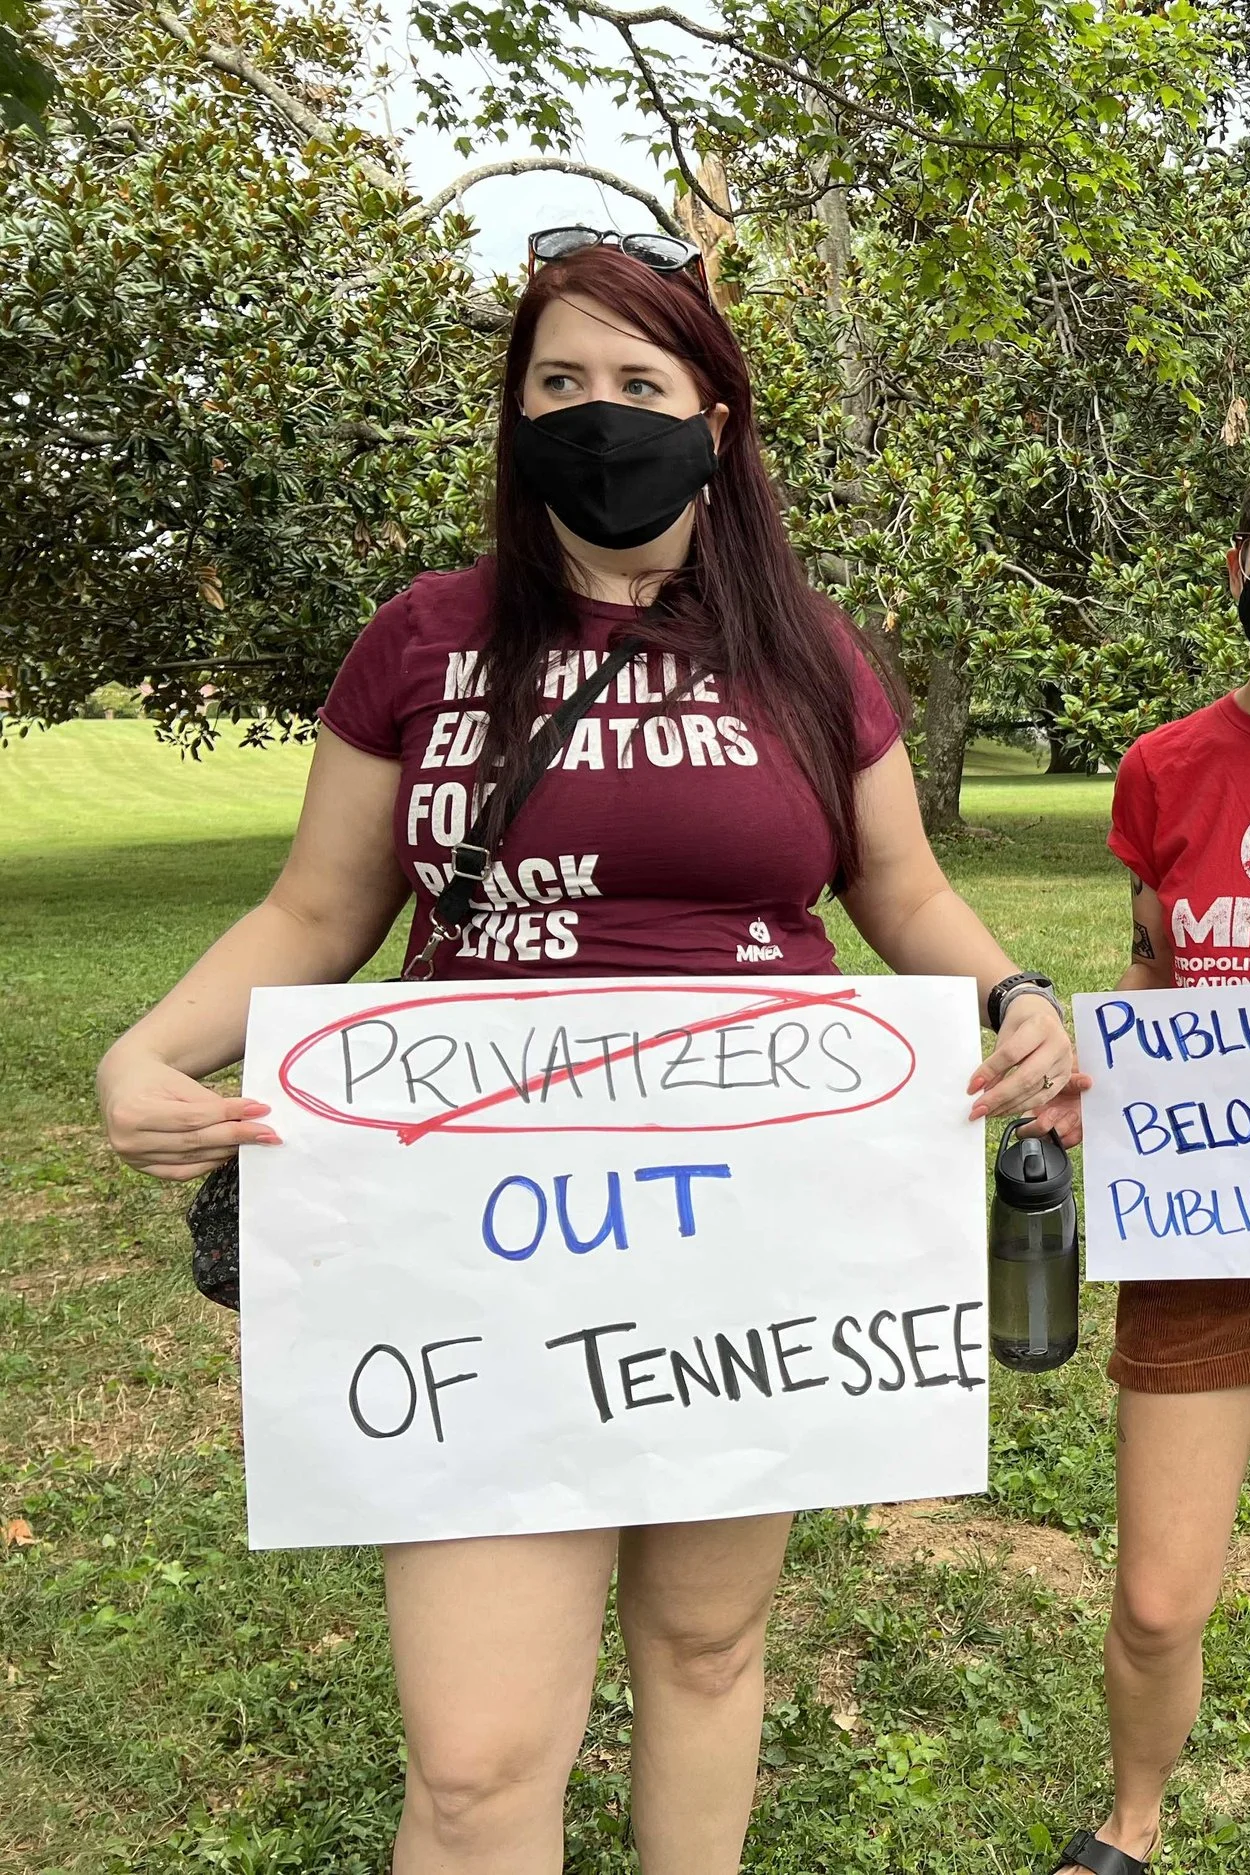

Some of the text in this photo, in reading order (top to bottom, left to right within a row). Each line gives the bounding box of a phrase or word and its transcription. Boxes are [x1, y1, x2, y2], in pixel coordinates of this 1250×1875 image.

[420, 711, 758, 769] EDATORS
[456, 909, 579, 961] LIVES
[736, 944, 784, 962] MNEA
[340, 1019, 863, 1108] PRIVATIZERS
[482, 1164, 731, 1261] OUT
[349, 1301, 986, 1443] OF TENNESSEE
